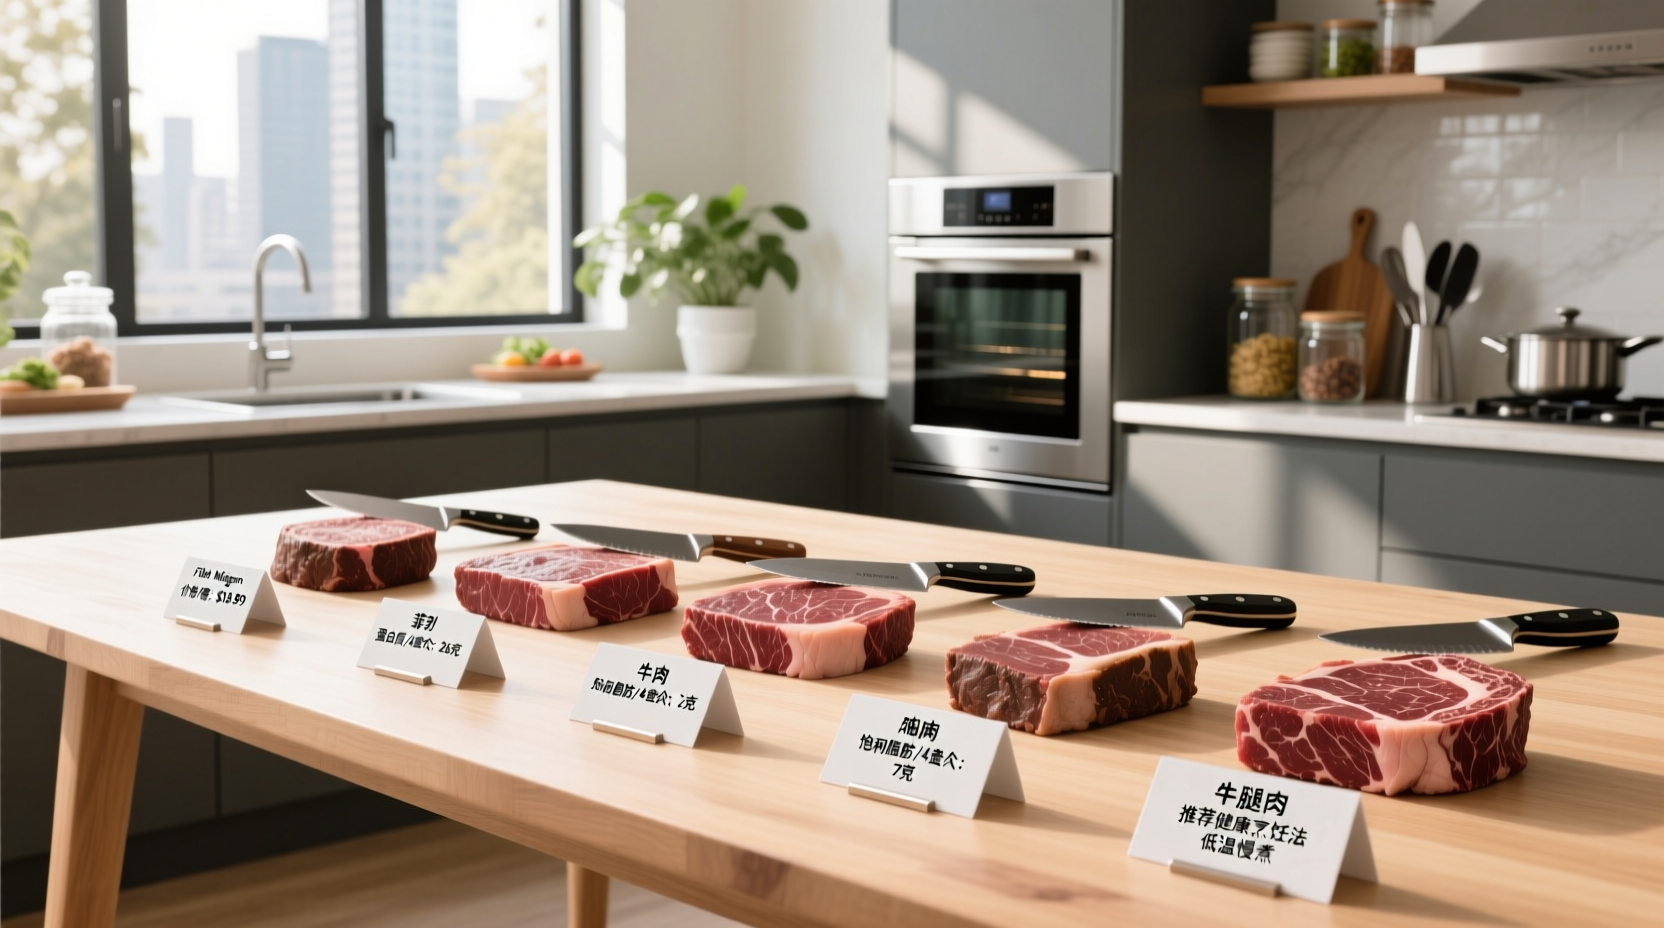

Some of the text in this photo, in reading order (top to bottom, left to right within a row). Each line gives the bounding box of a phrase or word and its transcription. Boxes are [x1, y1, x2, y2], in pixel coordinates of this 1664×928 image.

[637, 662, 670, 685] 牛肉
[1214, 781, 1289, 817] 牛腿肉
[1200, 832, 1276, 865] 低温慢煮
